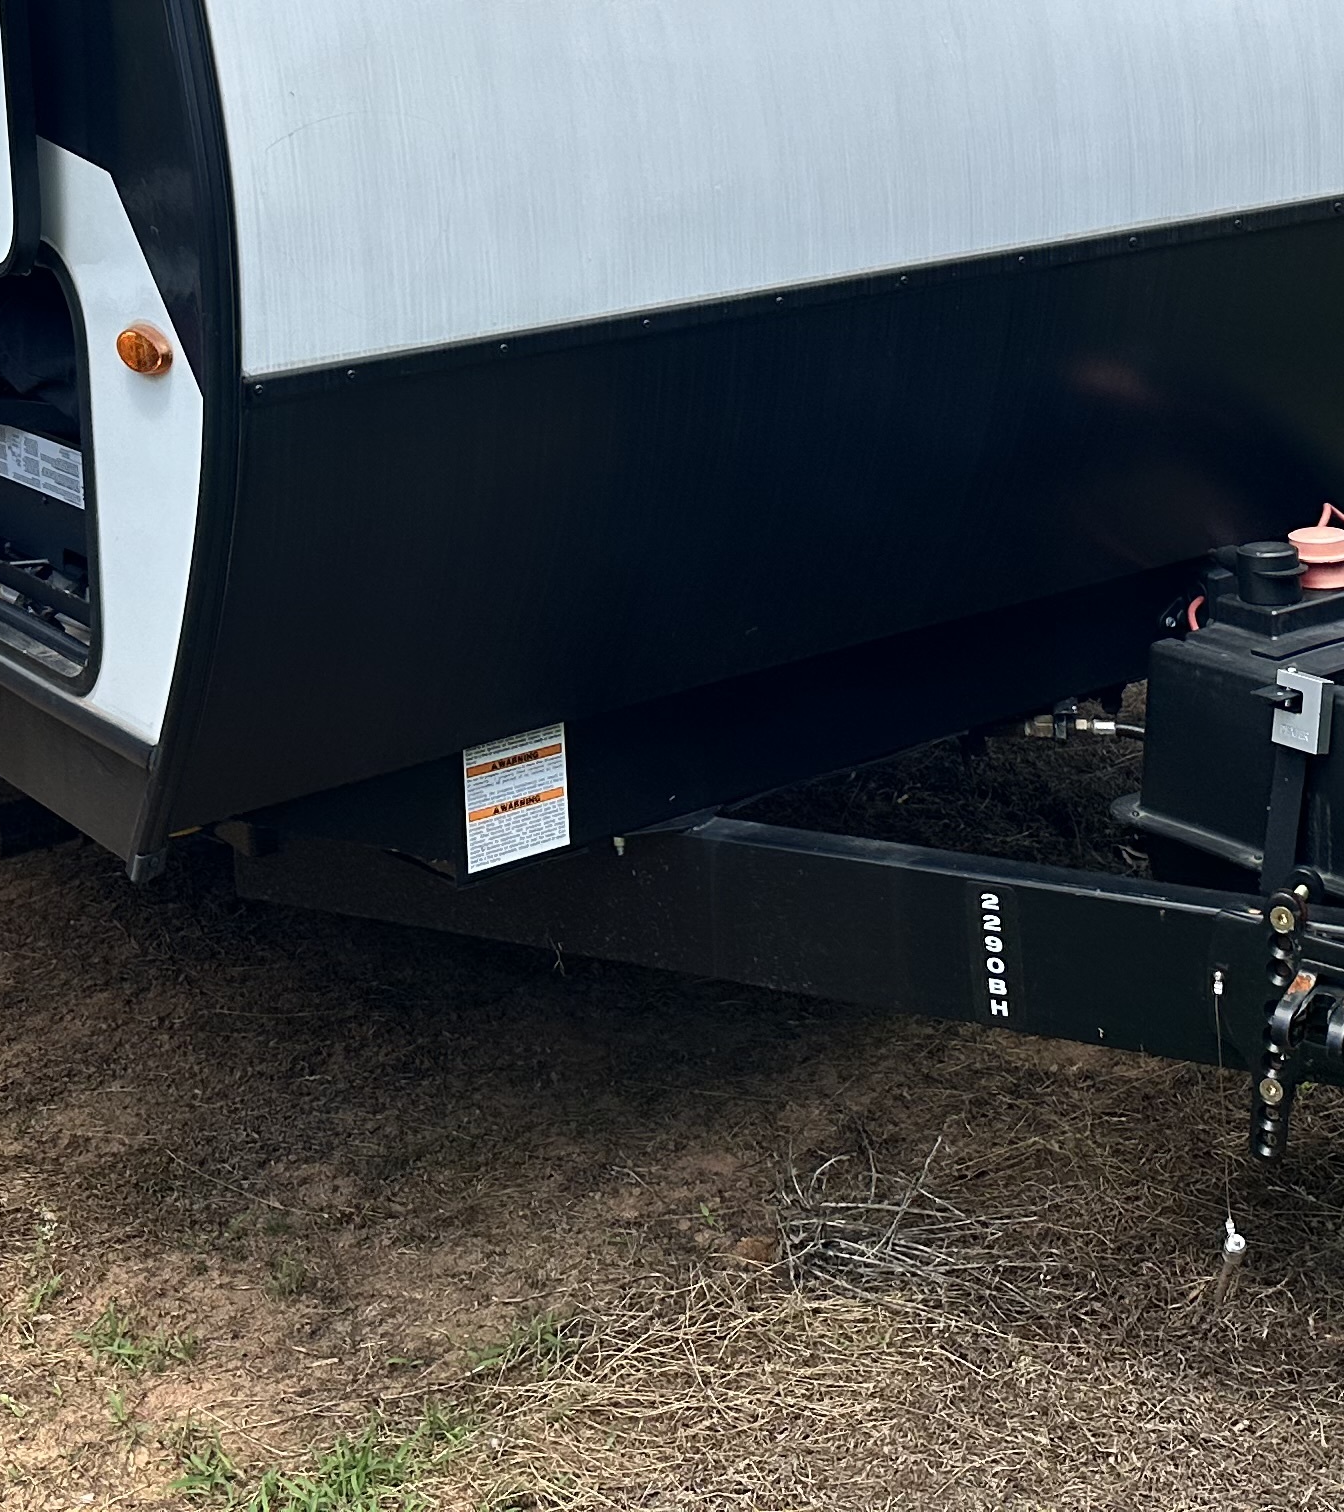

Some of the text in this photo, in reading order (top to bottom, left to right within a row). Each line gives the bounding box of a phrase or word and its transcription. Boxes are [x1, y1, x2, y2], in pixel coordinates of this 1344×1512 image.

[498, 750, 539, 769] WARNING
[500, 794, 541, 812] WARNING
[980, 892, 1009, 1017] 2290BH
